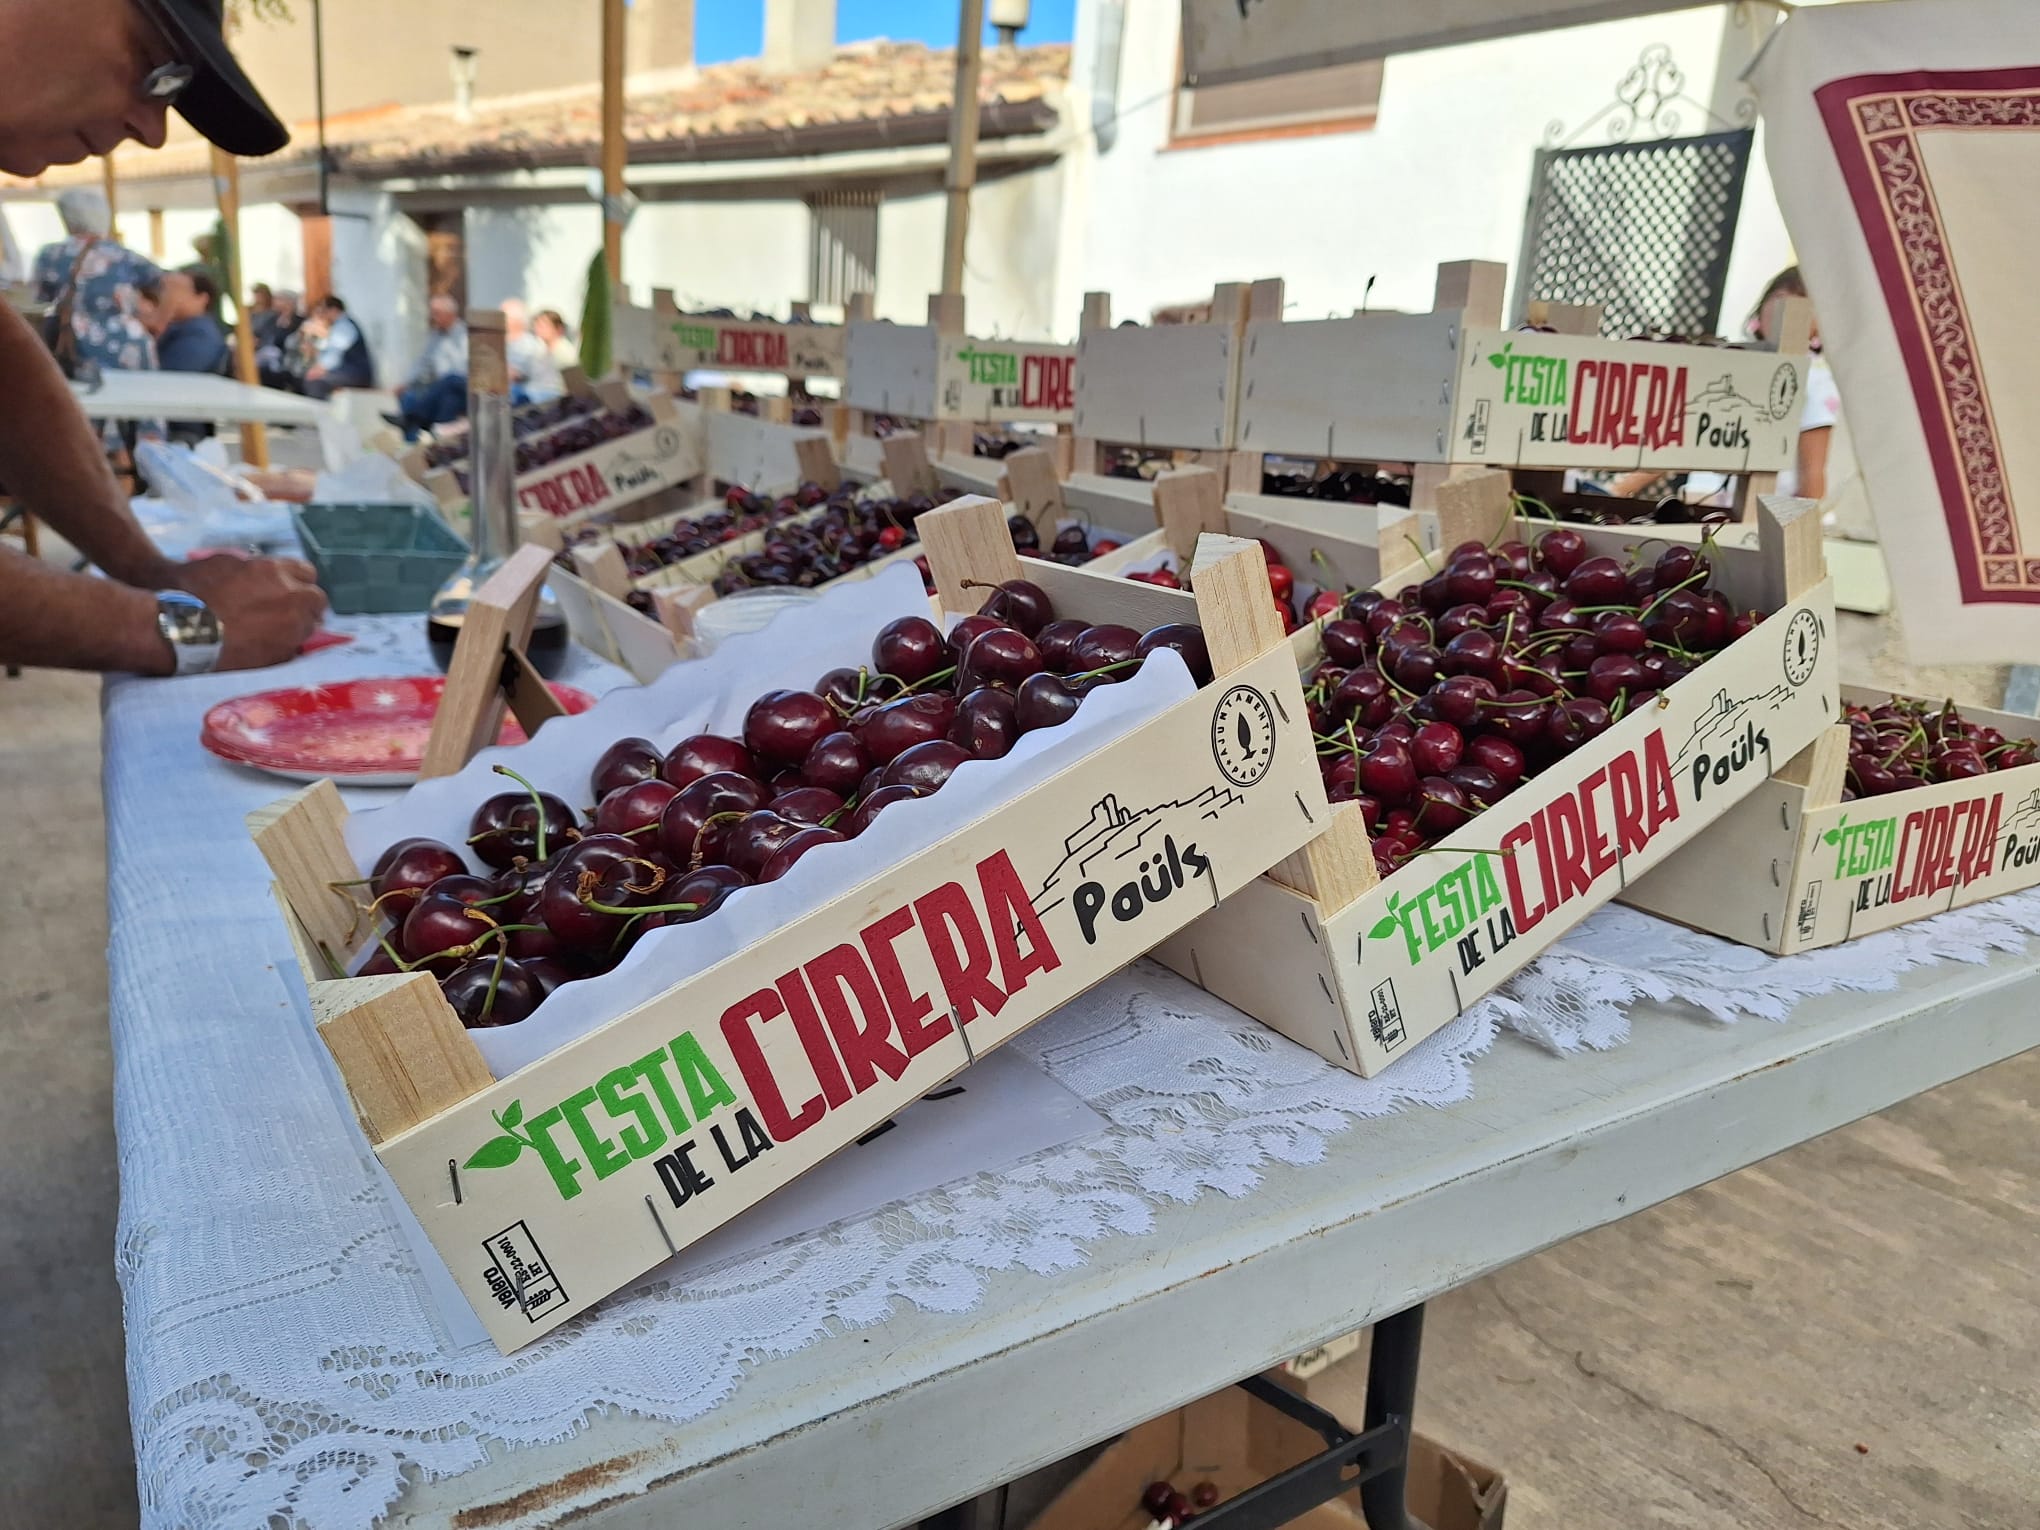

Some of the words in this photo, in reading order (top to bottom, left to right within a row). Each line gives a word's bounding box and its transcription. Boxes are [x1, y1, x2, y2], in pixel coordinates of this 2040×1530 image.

[720, 329, 788, 367] CIRERA
[970, 351, 1017, 384] FESTA
[1504, 355, 1568, 406] FESTA
[1530, 412, 1547, 442] DE
[1551, 413, 1568, 442] LA
[1567, 360, 1688, 451] CIRERA
[1696, 412, 1750, 449] Paüls
[1692, 720, 1769, 802] Paüls
[1500, 727, 1680, 935] CIRERA
[1835, 817, 1898, 880] FESTA
[1891, 792, 2004, 904] CIRERA
[1073, 834, 1208, 944] Paüls
[1398, 853, 1502, 966] FESTA
[1855, 878, 1874, 912] DE
[1874, 873, 1893, 906] LA
[1456, 928, 1486, 976] DE
[1486, 907, 1517, 954] LA
[720, 848, 1061, 1143] CIRERA
[524, 1031, 737, 1200] FESTA
[653, 1139, 715, 1209] DE
[710, 1107, 775, 1174] LA
[483, 1266, 516, 1310] valero
[527, 1261, 544, 1277] HT
